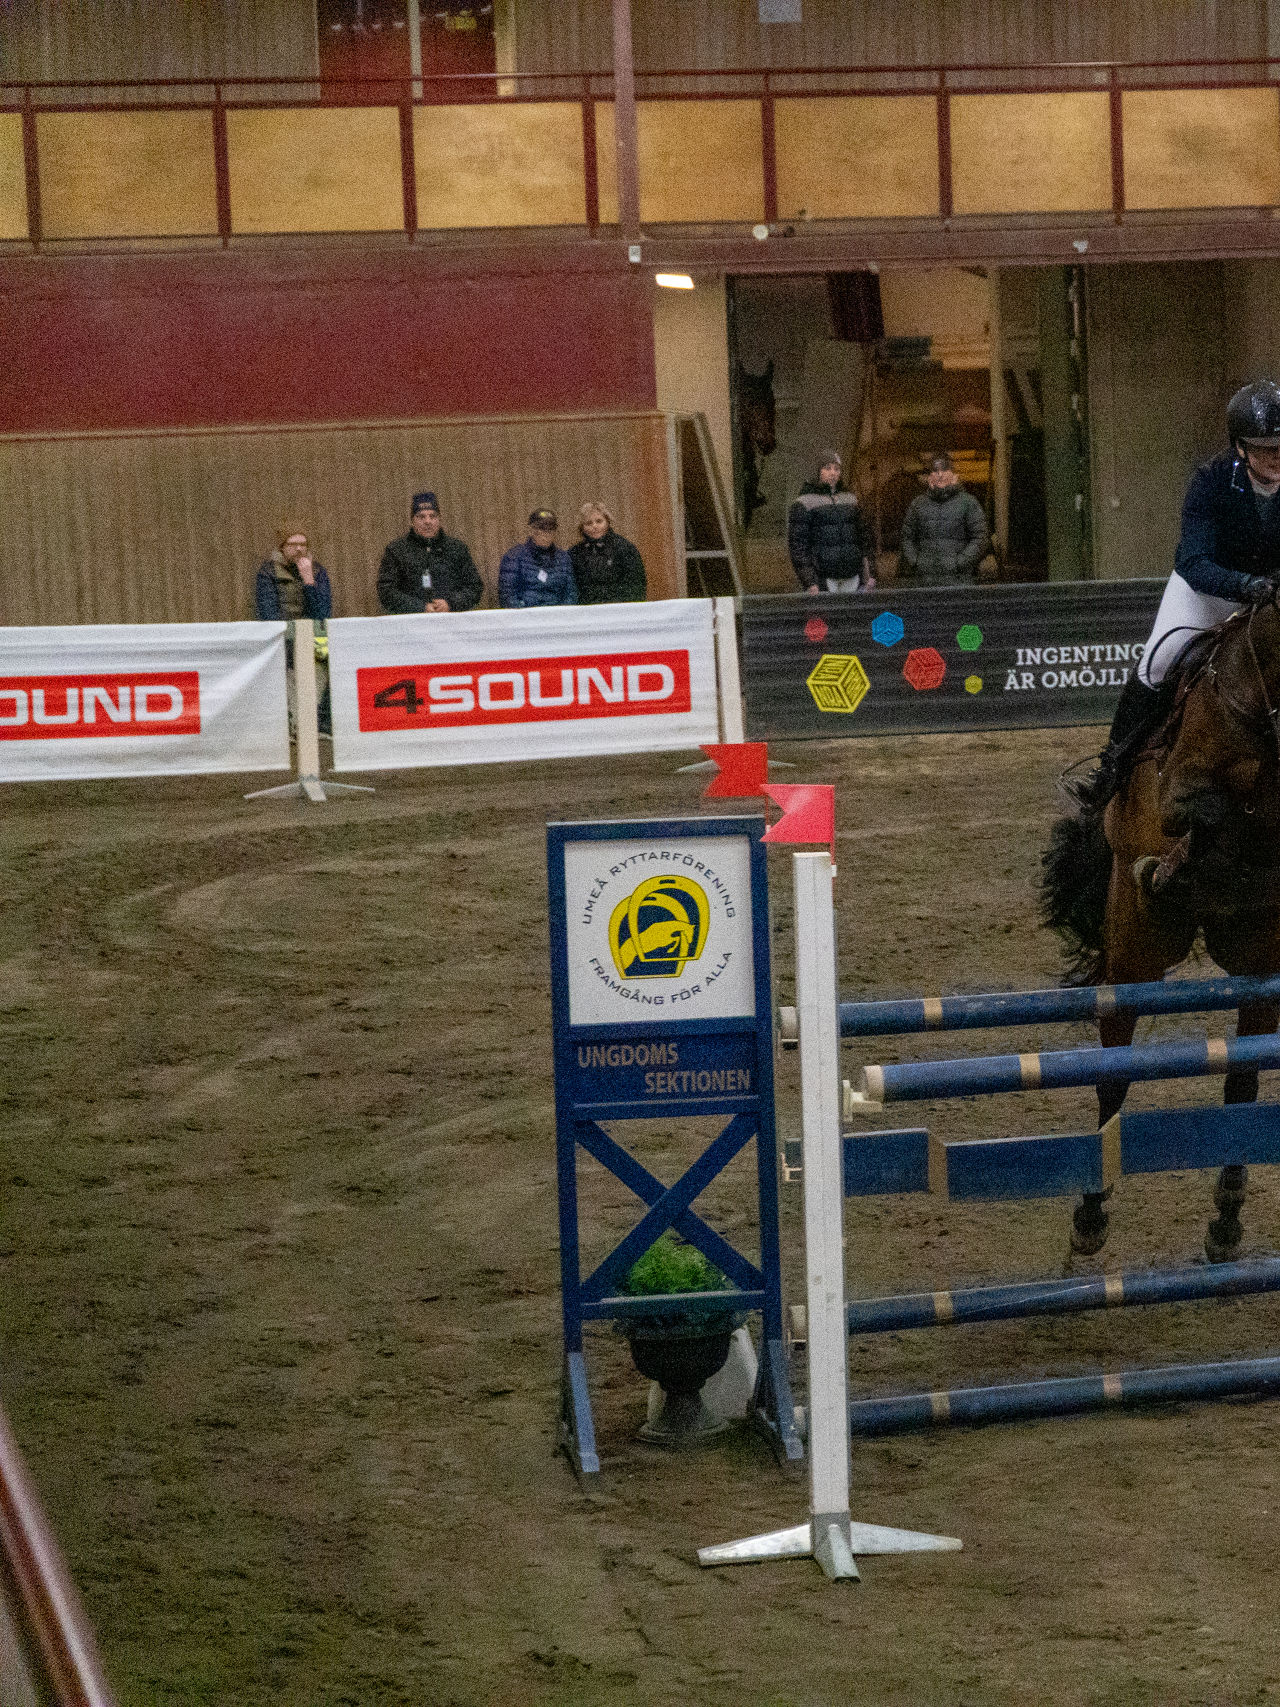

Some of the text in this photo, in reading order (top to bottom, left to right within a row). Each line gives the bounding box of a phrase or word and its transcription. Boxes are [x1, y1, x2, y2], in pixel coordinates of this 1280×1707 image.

[1016, 643, 1147, 666] INGENTING
[373, 663, 676, 715] 4SOUND
[1004, 669, 1036, 690] ÄR
[583, 851, 736, 924] UMEÅ RYTTARFÖRENING
[588, 952, 733, 1005] FRAMGÅNG FÖR ALLA
[578, 1043, 679, 1068] UNGDOMS
[644, 1069, 751, 1094] SEKTIONEN
